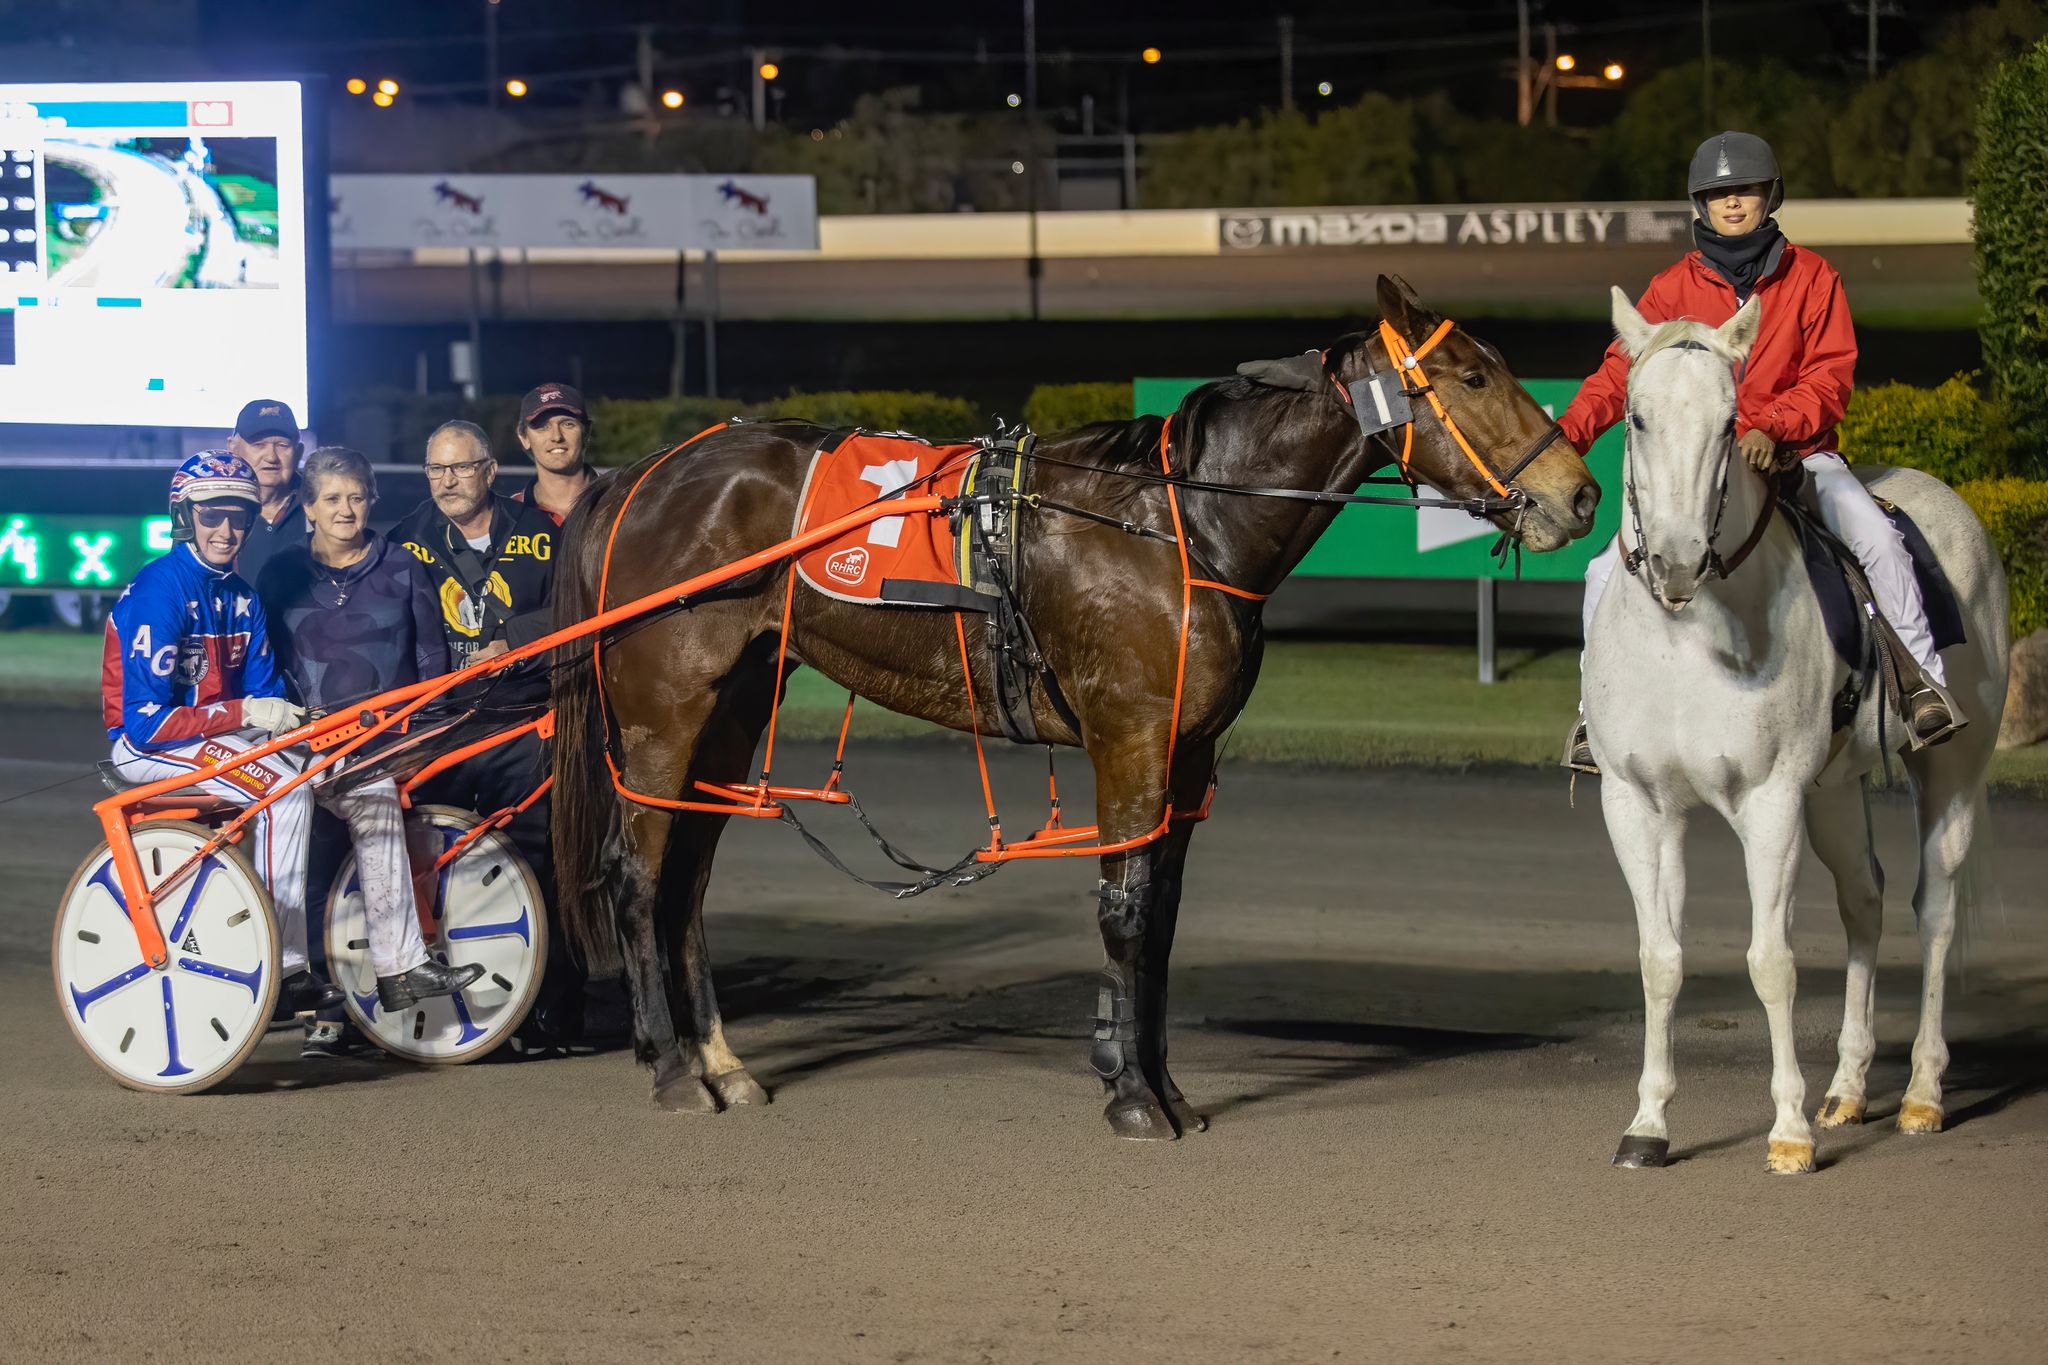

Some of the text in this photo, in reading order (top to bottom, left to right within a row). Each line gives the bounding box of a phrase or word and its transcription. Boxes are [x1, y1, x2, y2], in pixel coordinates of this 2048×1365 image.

[1457, 209, 1614, 244] ASPLEY
[860, 457, 918, 548] 1
[830, 561, 862, 575] RHRC
[205, 744, 274, 784] GARRD'S
[240, 772, 265, 791] HOUND
